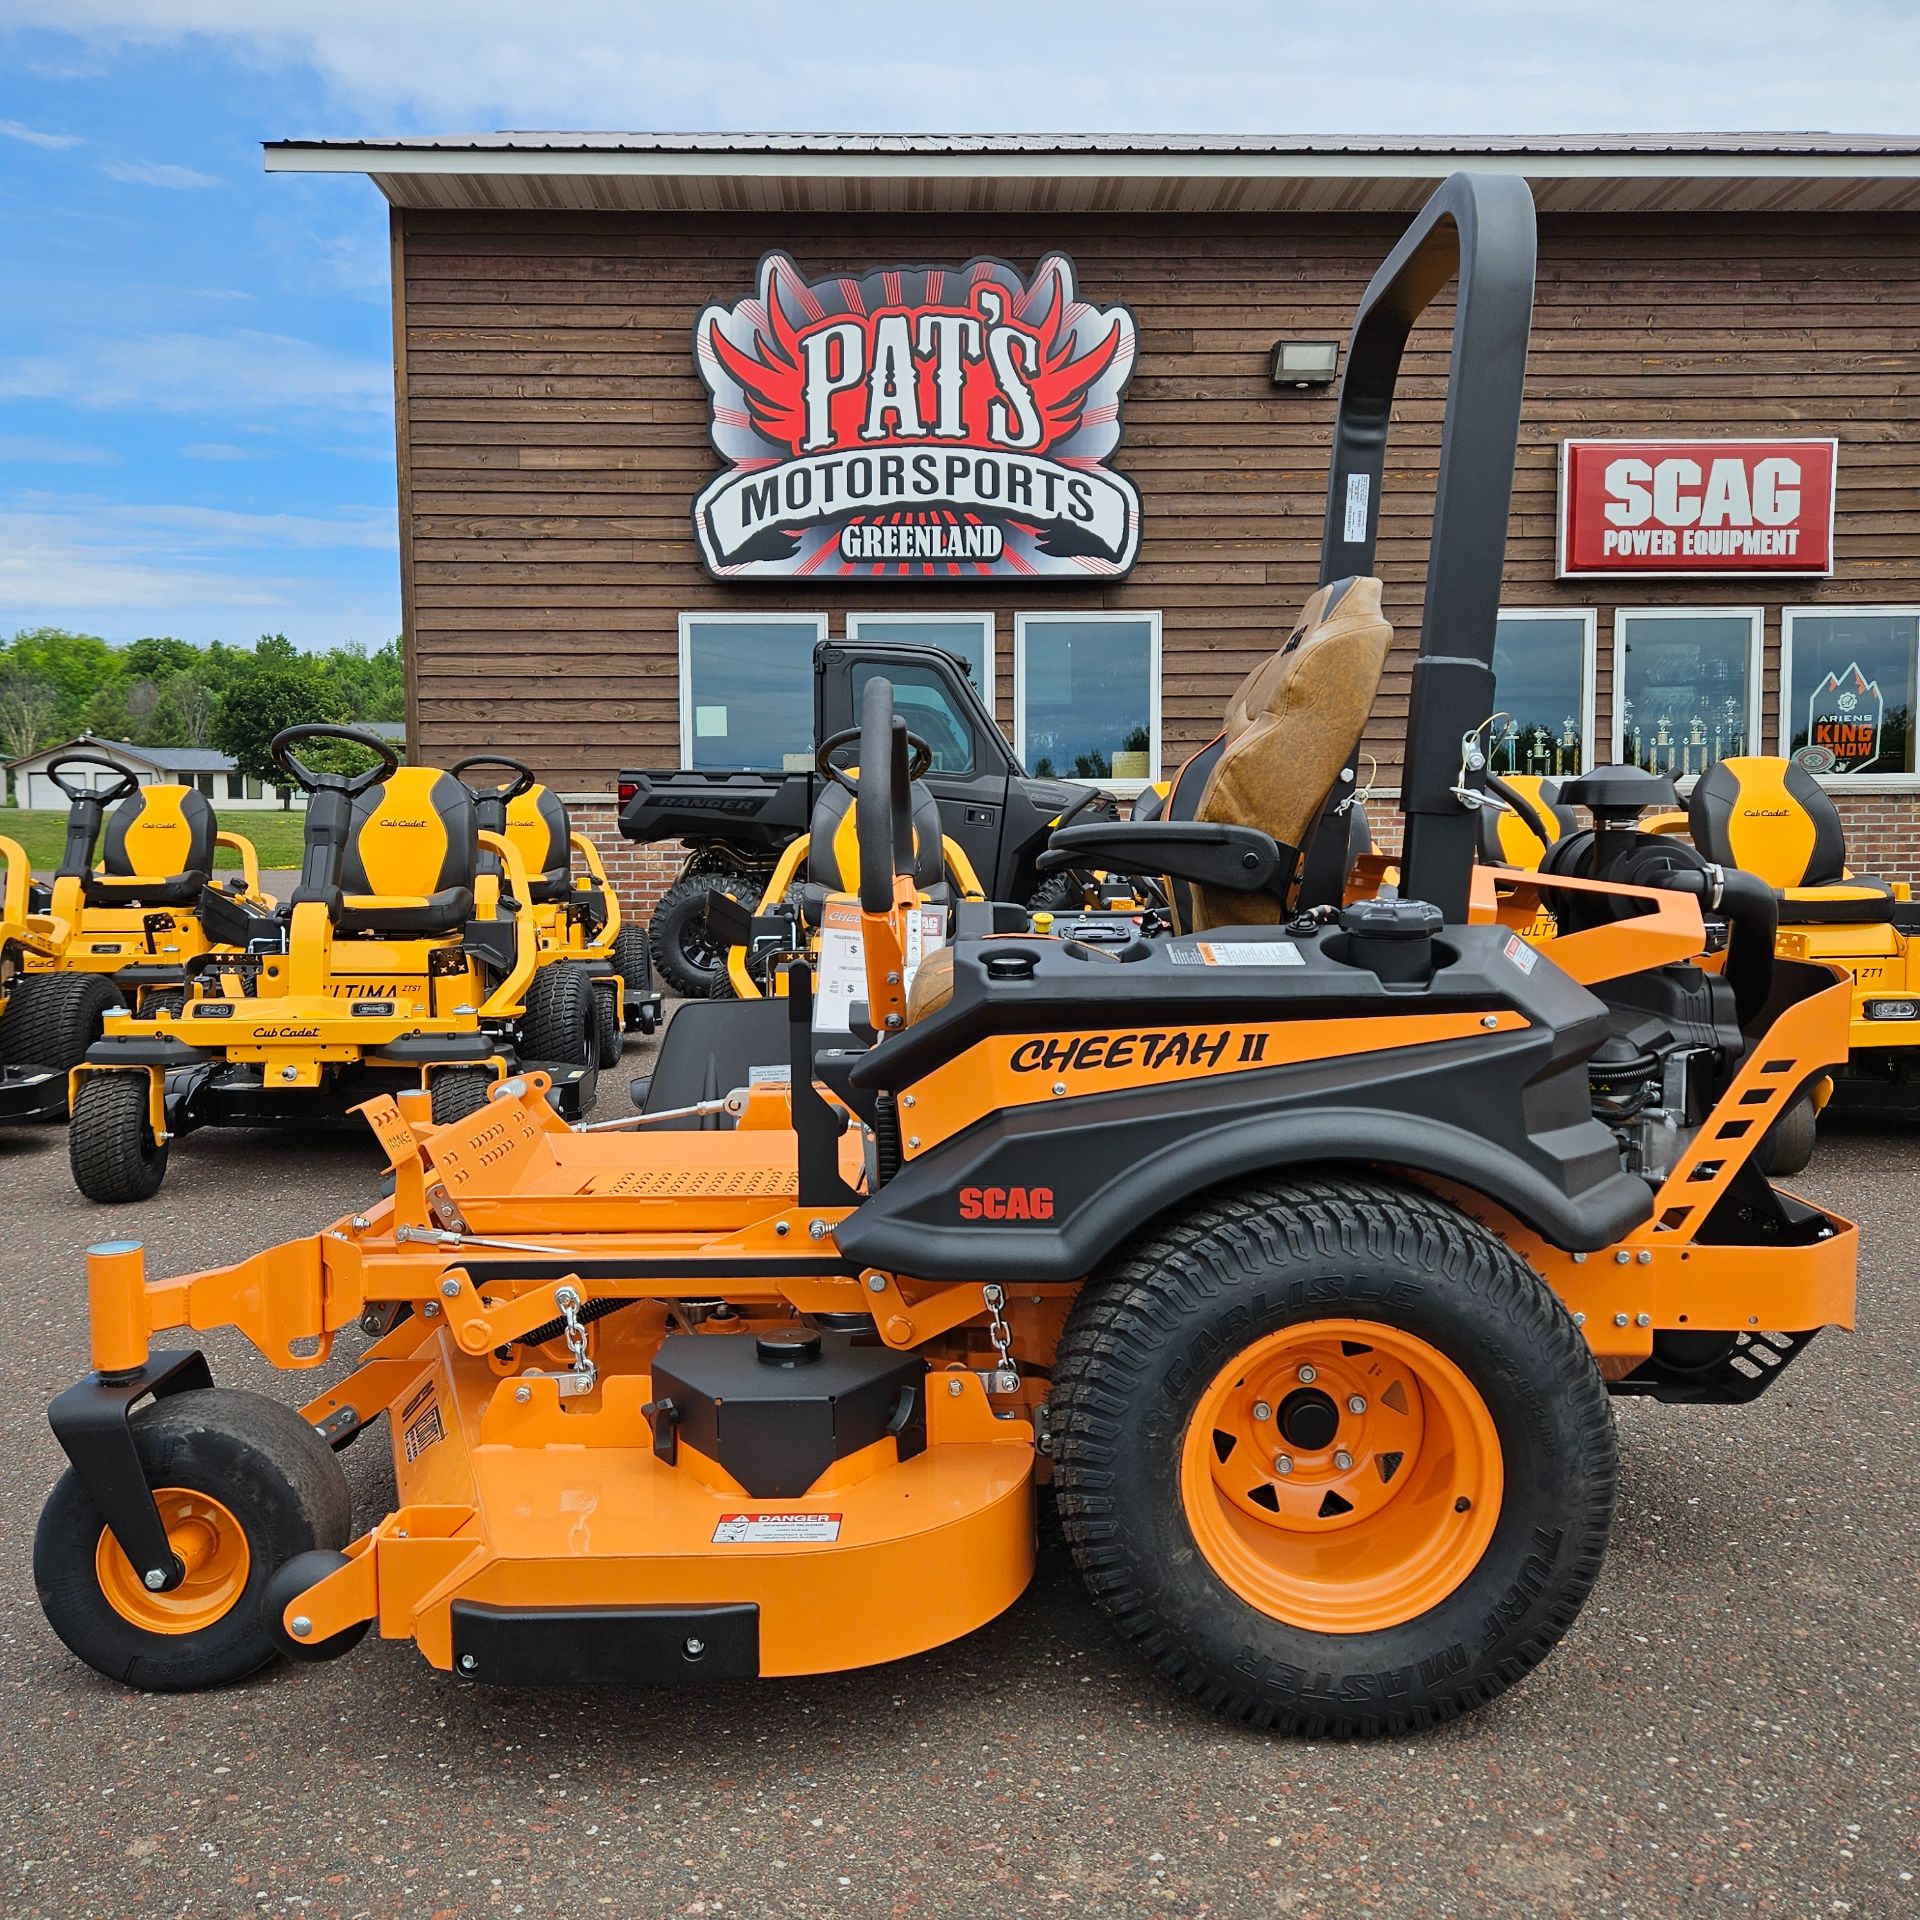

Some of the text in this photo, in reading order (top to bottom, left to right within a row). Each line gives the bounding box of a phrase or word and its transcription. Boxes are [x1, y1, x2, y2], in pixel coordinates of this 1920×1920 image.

[801, 291, 1042, 451] PAT'S
[740, 453, 1095, 529] MOTORSPORTS
[1604, 457, 1802, 526] SCAG
[841, 525, 1003, 558] GREENLAND
[1603, 529, 1800, 556] POWER EQUIPMENT
[1818, 714, 1873, 723] ARIENS
[1816, 723, 1874, 744] KING
[658, 796, 754, 810] RANGER
[1743, 809, 1791, 817] Cub Cadet
[379, 818, 428, 828] Cub Cadet
[1861, 968, 1884, 978] ZT1
[401, 984, 422, 993] ZTS1
[252, 1027, 321, 1038] Cub Cadet
[1010, 1030, 1270, 1073] CHEETAH II
[959, 1187, 1054, 1219] SCAG
[1161, 1272, 1425, 1400] CARLISLE
[757, 1514, 830, 1522] DANGER
[1231, 1525, 1564, 1702] TURF MASTER
